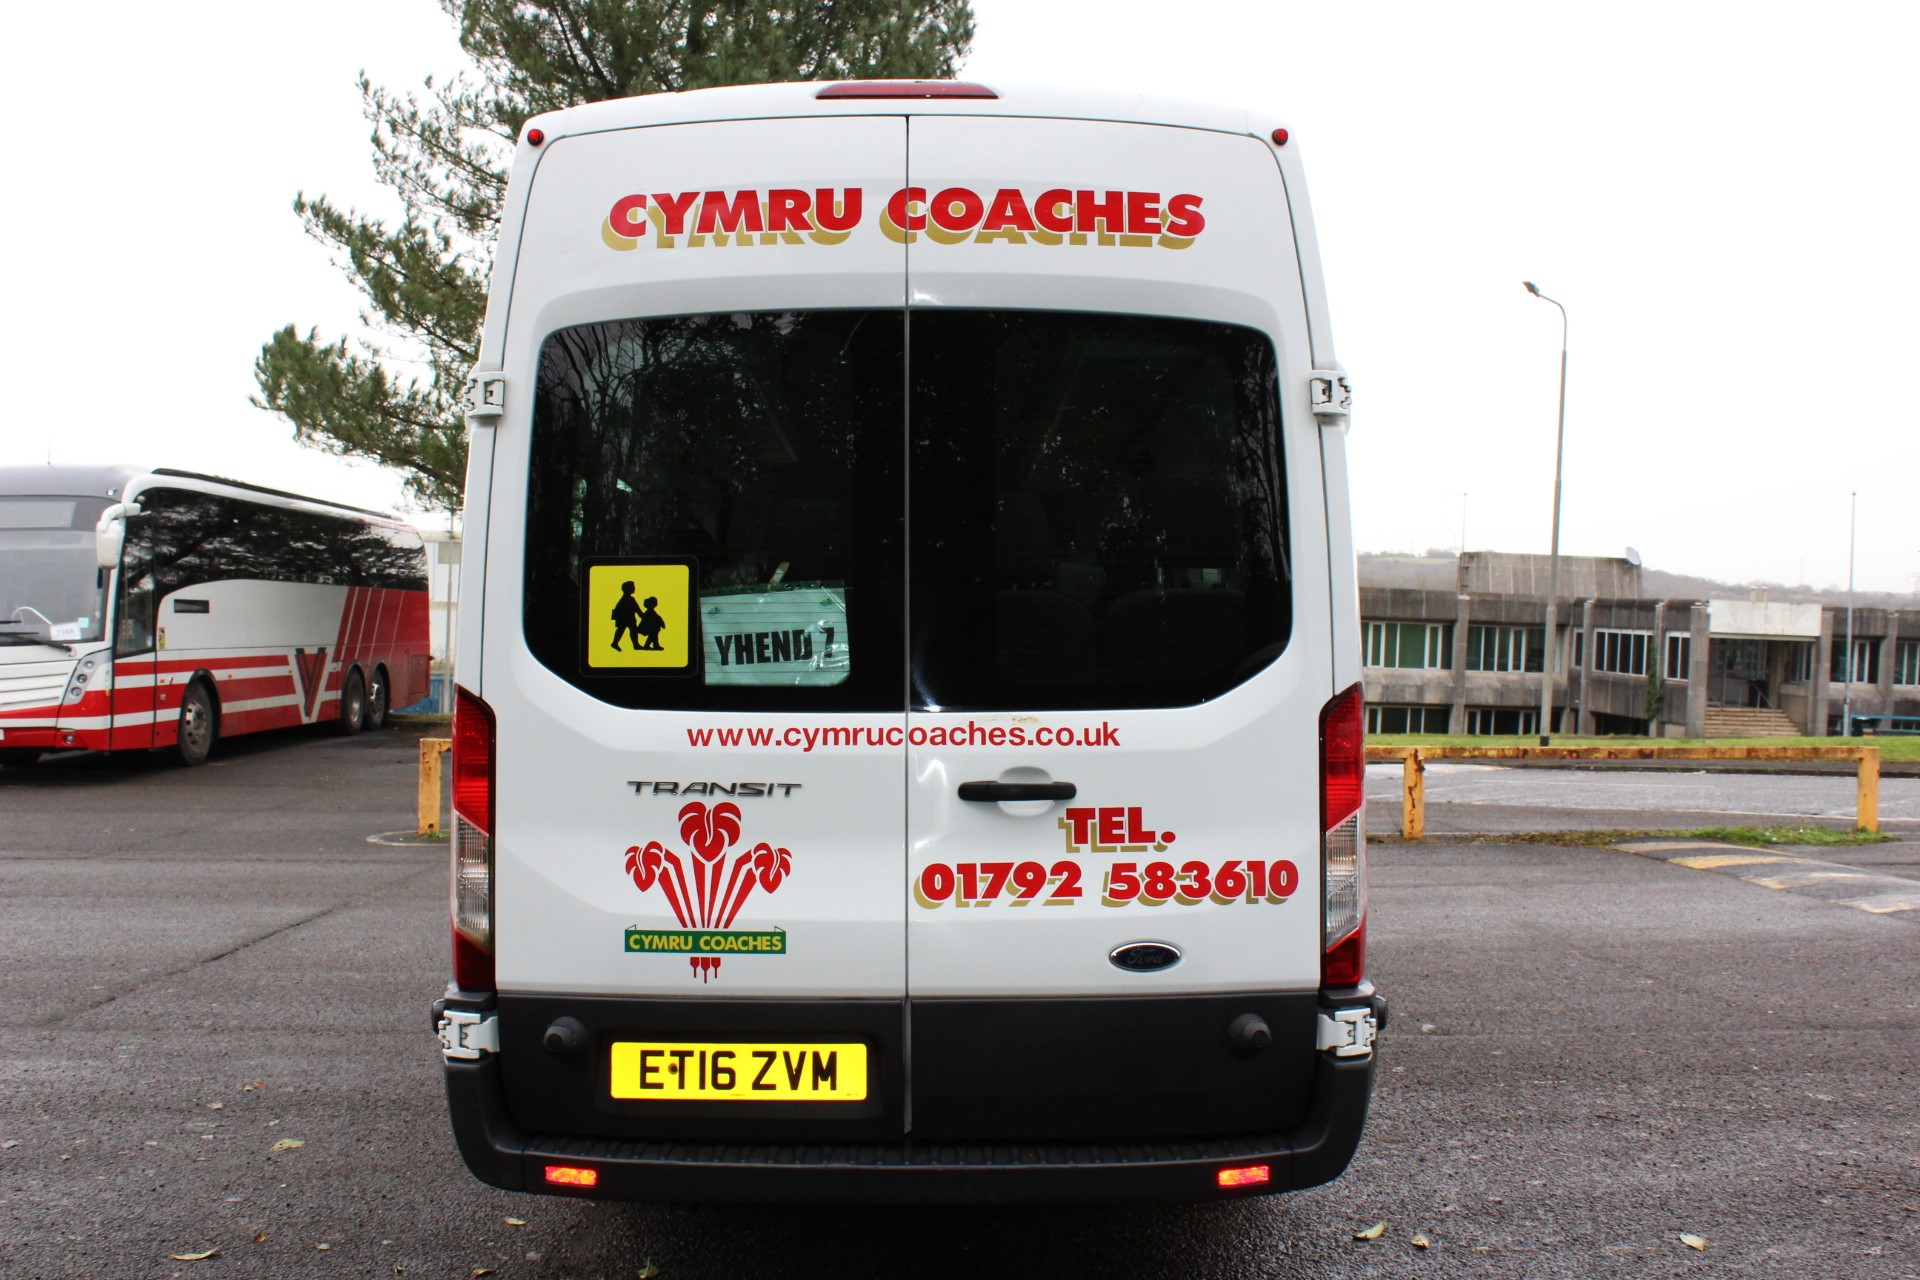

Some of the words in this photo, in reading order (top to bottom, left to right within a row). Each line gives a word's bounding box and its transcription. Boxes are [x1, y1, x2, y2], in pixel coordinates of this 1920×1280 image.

[601, 187, 863, 251] CYMRU
[879, 187, 1206, 250] COACHES
[714, 628, 813, 667] YHEND
[686, 721, 1121, 752] www.cymrucoaches.co.uk
[627, 780, 802, 798] TRANSIT
[1058, 806, 1176, 852] TEL.
[914, 861, 1083, 909] 01792
[1101, 859, 1299, 907] 583610
[629, 934, 693, 950] CYMRU
[699, 935, 782, 951] COACHES
[640, 1049, 737, 1091] ET16
[751, 1050, 838, 1091] ZVM
